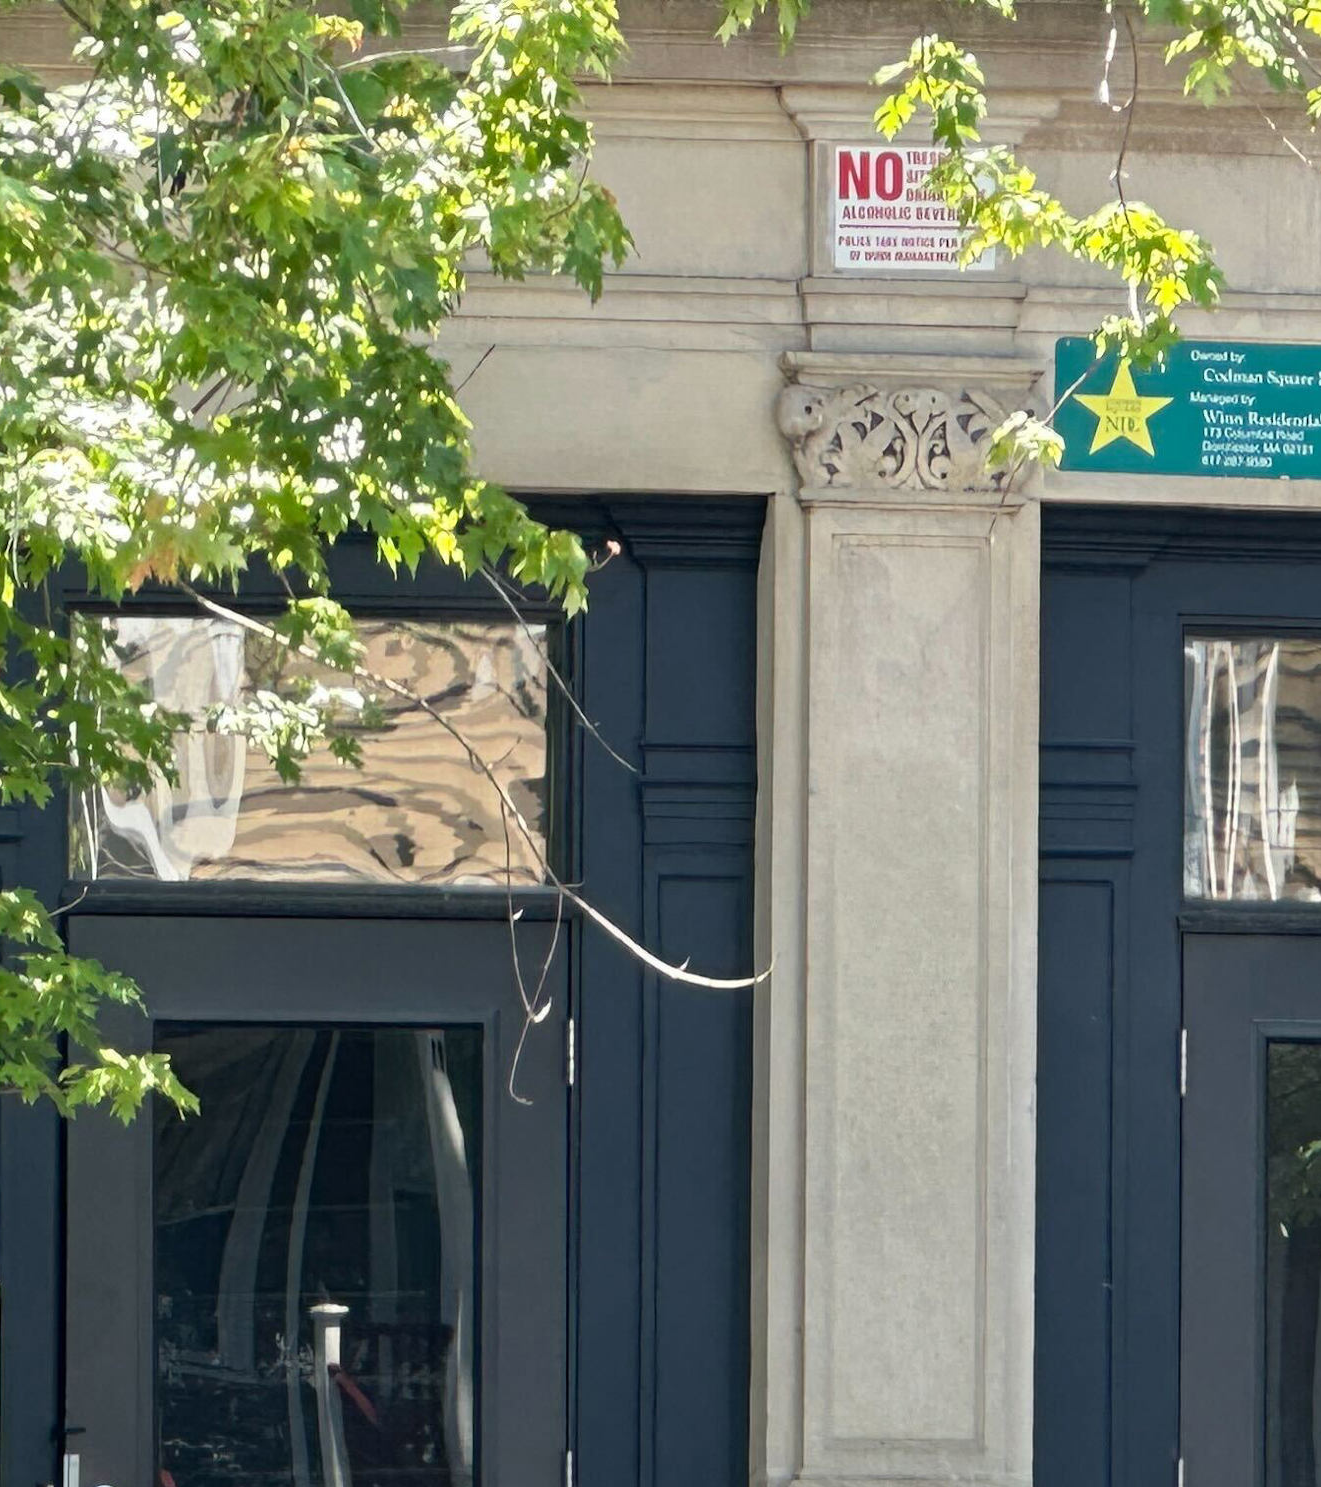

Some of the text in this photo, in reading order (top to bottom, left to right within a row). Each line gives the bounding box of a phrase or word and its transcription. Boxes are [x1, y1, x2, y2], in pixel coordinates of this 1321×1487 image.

[838, 151, 903, 201] NO
[842, 205, 912, 221] ALCOHOLIC
[1203, 367, 1264, 384] Codman
[1266, 369, 1315, 387] Square
[1202, 408, 1244, 426] Winn
